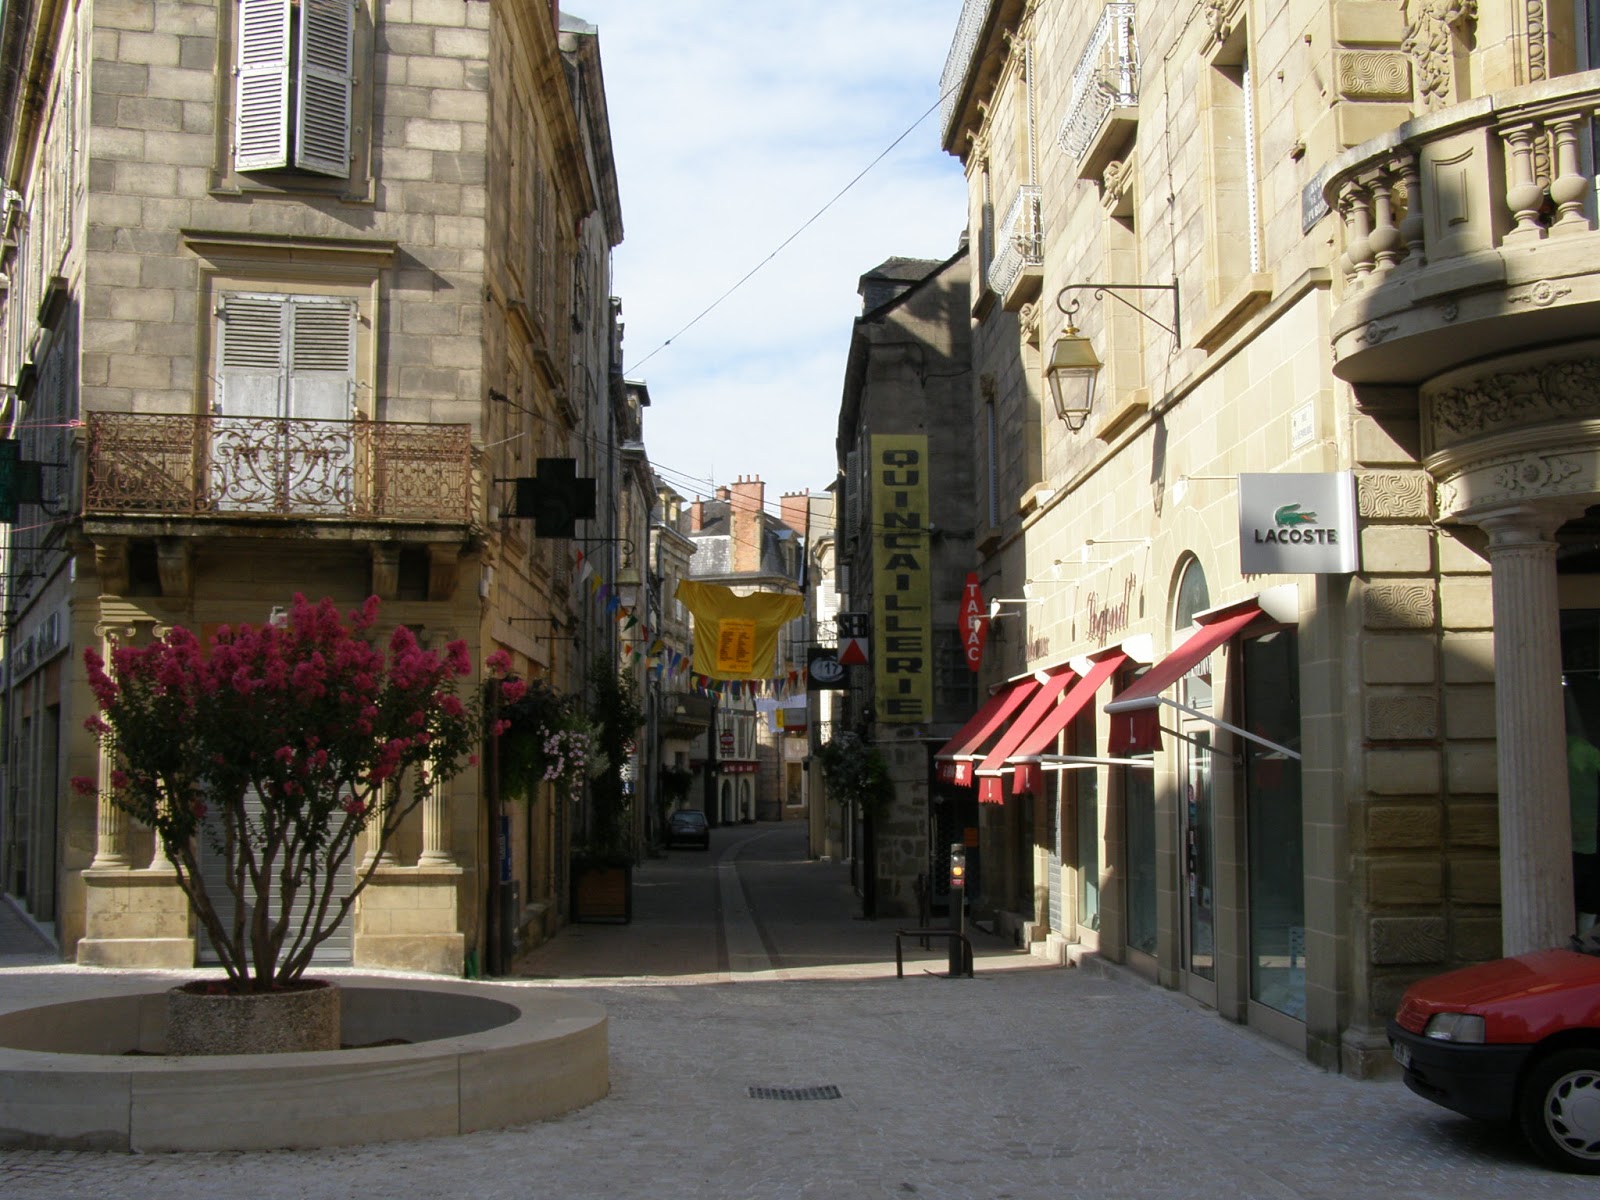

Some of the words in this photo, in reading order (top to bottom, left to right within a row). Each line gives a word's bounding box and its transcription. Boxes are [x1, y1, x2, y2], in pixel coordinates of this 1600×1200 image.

[1254, 528, 1338, 545] LACOSTE
[882, 449, 923, 715] QUINCAILLERIE
[966, 584, 980, 661] TABAC
